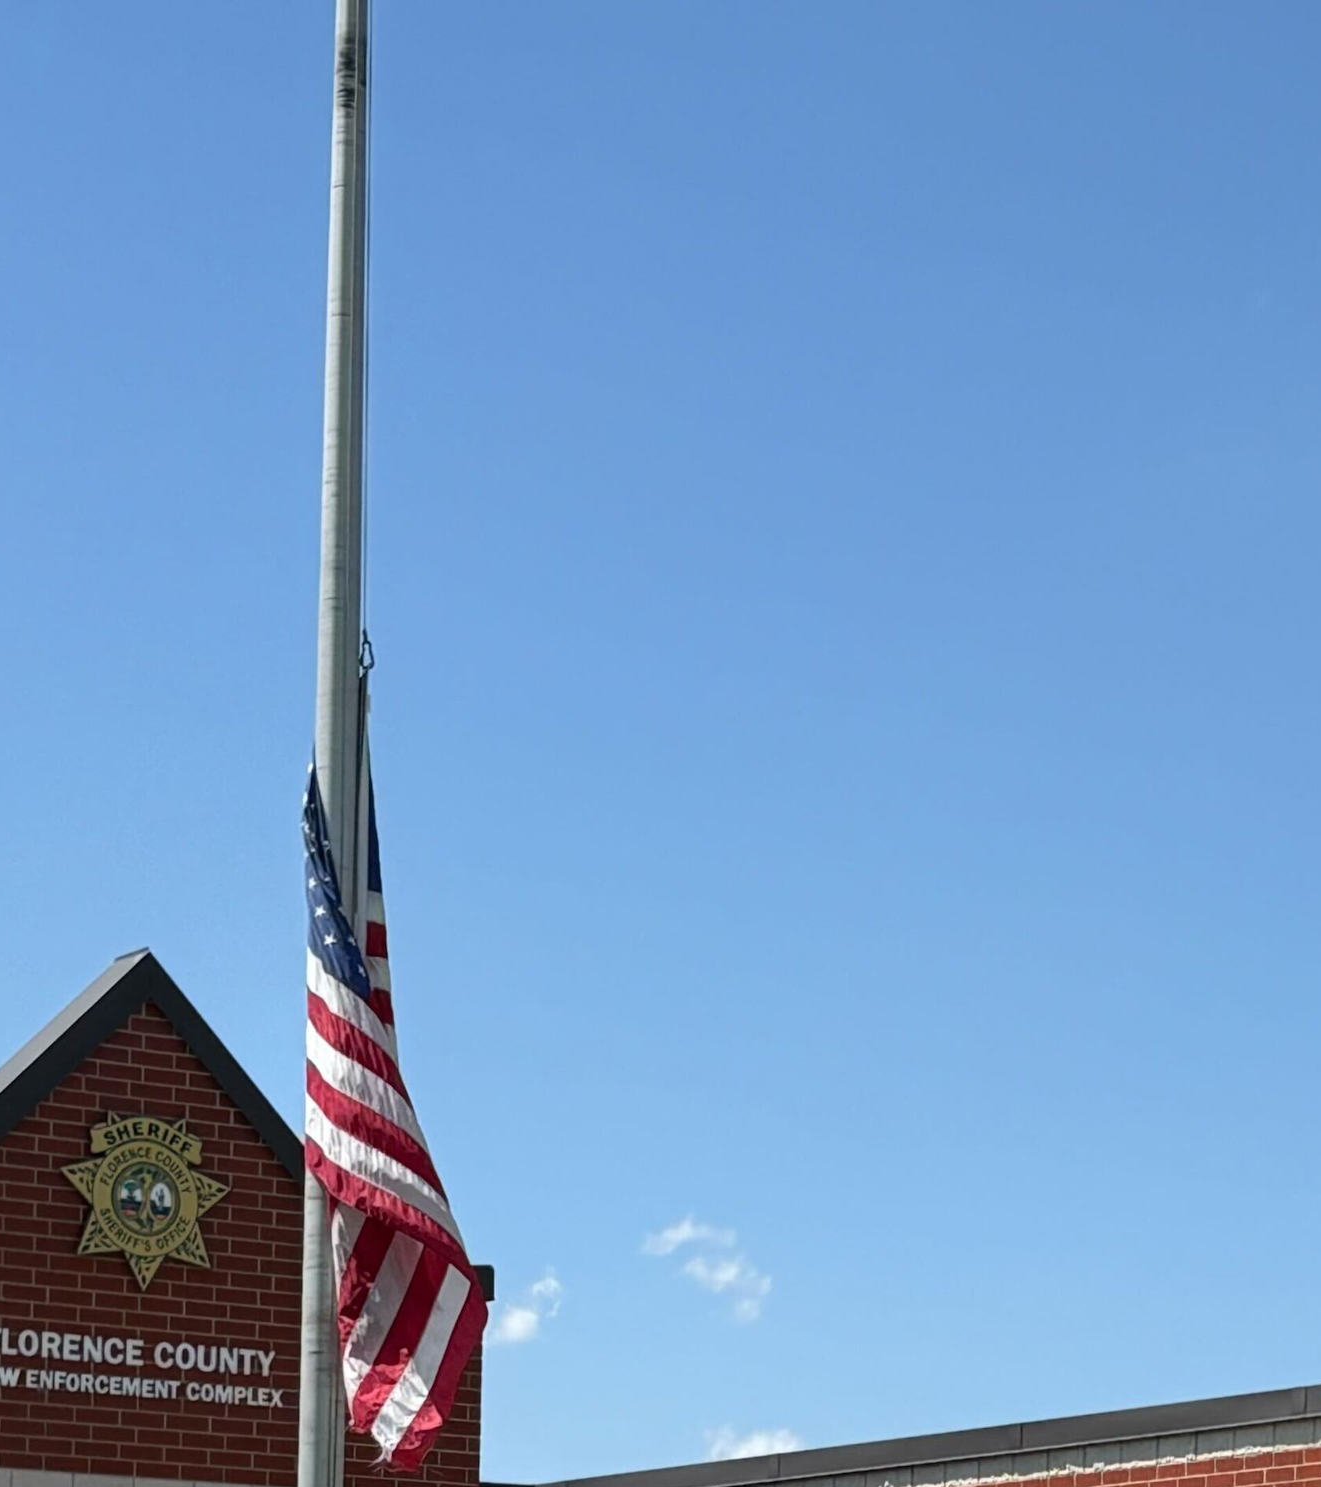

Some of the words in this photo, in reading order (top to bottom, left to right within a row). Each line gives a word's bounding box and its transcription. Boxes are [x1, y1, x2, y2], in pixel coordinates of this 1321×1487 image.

[103, 1121, 193, 1154] SHERIFF
[100, 1146, 152, 1186] FLORENCE
[155, 1151, 192, 1193] COUNTY
[100, 1208, 151, 1252] SHERIFF'S
[156, 1216, 190, 1250] OFFICE
[153, 1341, 276, 1377] COUNTY
[26, 1369, 181, 1400] ENFORCEMENT
[185, 1382, 284, 1408] COMPLEX
